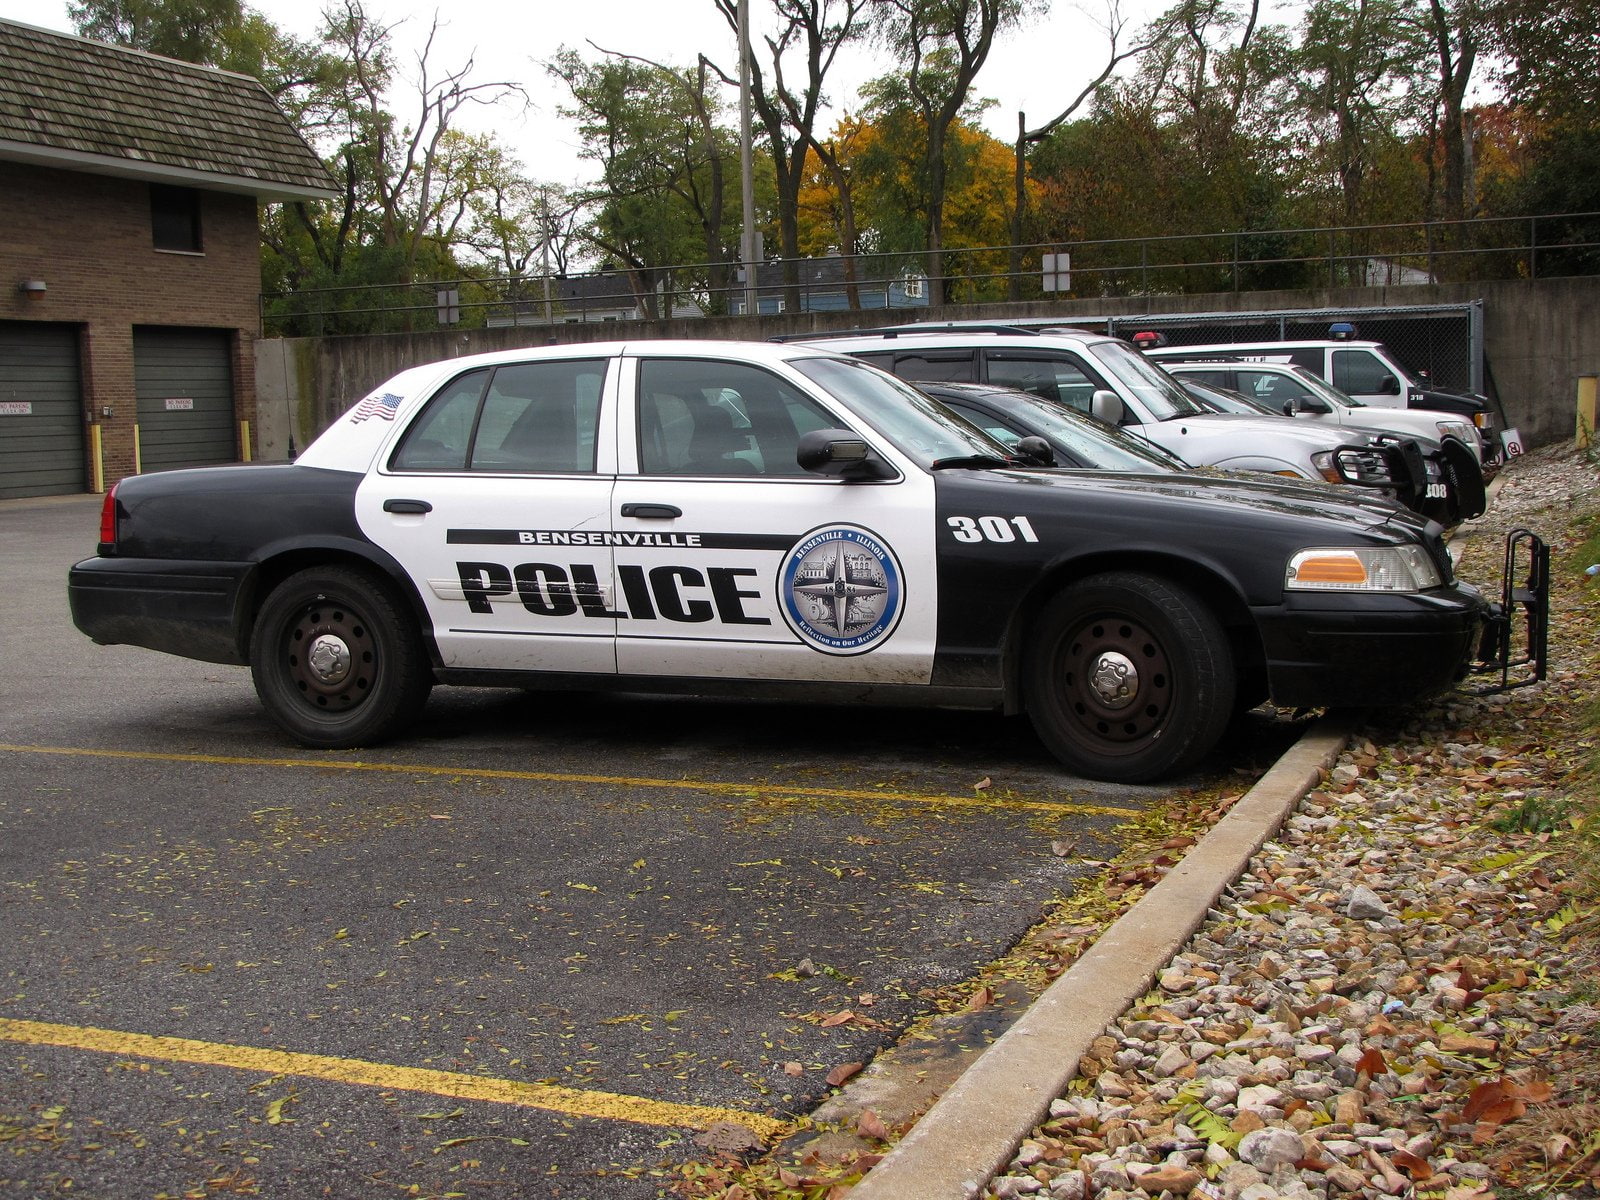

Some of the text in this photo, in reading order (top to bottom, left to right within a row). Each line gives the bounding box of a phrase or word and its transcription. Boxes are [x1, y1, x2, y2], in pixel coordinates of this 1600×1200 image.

[518, 531, 702, 547] BENSENVILLE
[946, 516, 1040, 543] 301
[795, 531, 886, 561] BENSENVILLE ILLINOIS
[456, 561, 772, 626] POLICE
[799, 620, 830, 644] Reflection
[842, 637, 855, 646] Our
[857, 624, 884, 644] Heritage
